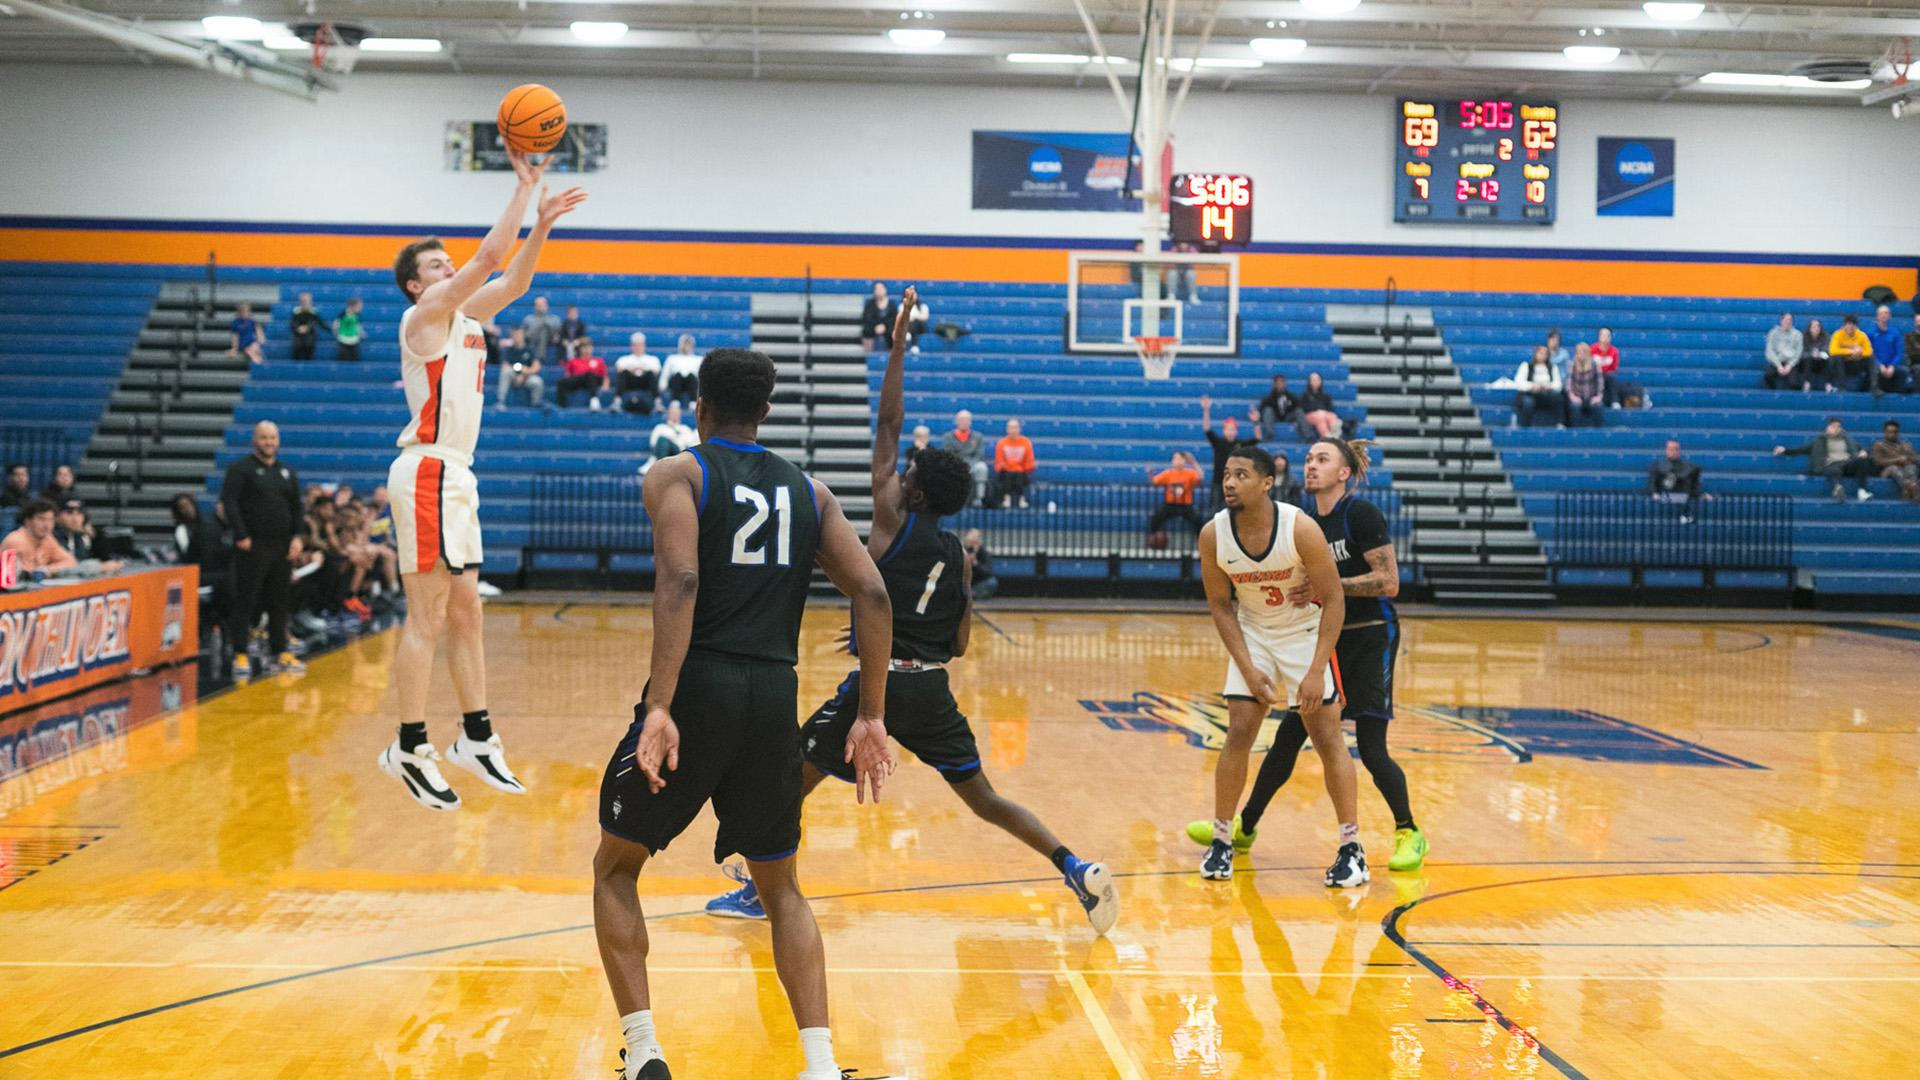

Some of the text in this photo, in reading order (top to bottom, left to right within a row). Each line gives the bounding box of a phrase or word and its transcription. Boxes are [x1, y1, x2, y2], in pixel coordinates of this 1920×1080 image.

[1405, 118, 1438, 147] 69
[1523, 120, 1557, 149] 62
[1498, 138, 1513, 160] 2
[1619, 161, 1655, 174] NCAA
[1190, 176, 1249, 206] 5:06
[1414, 177, 1429, 200] 7
[1525, 181, 1546, 203] 10
[1202, 205, 1233, 240] 14
[732, 485, 791, 566] 21
[916, 561, 945, 615] 1
[1260, 585, 1285, 607] 3
